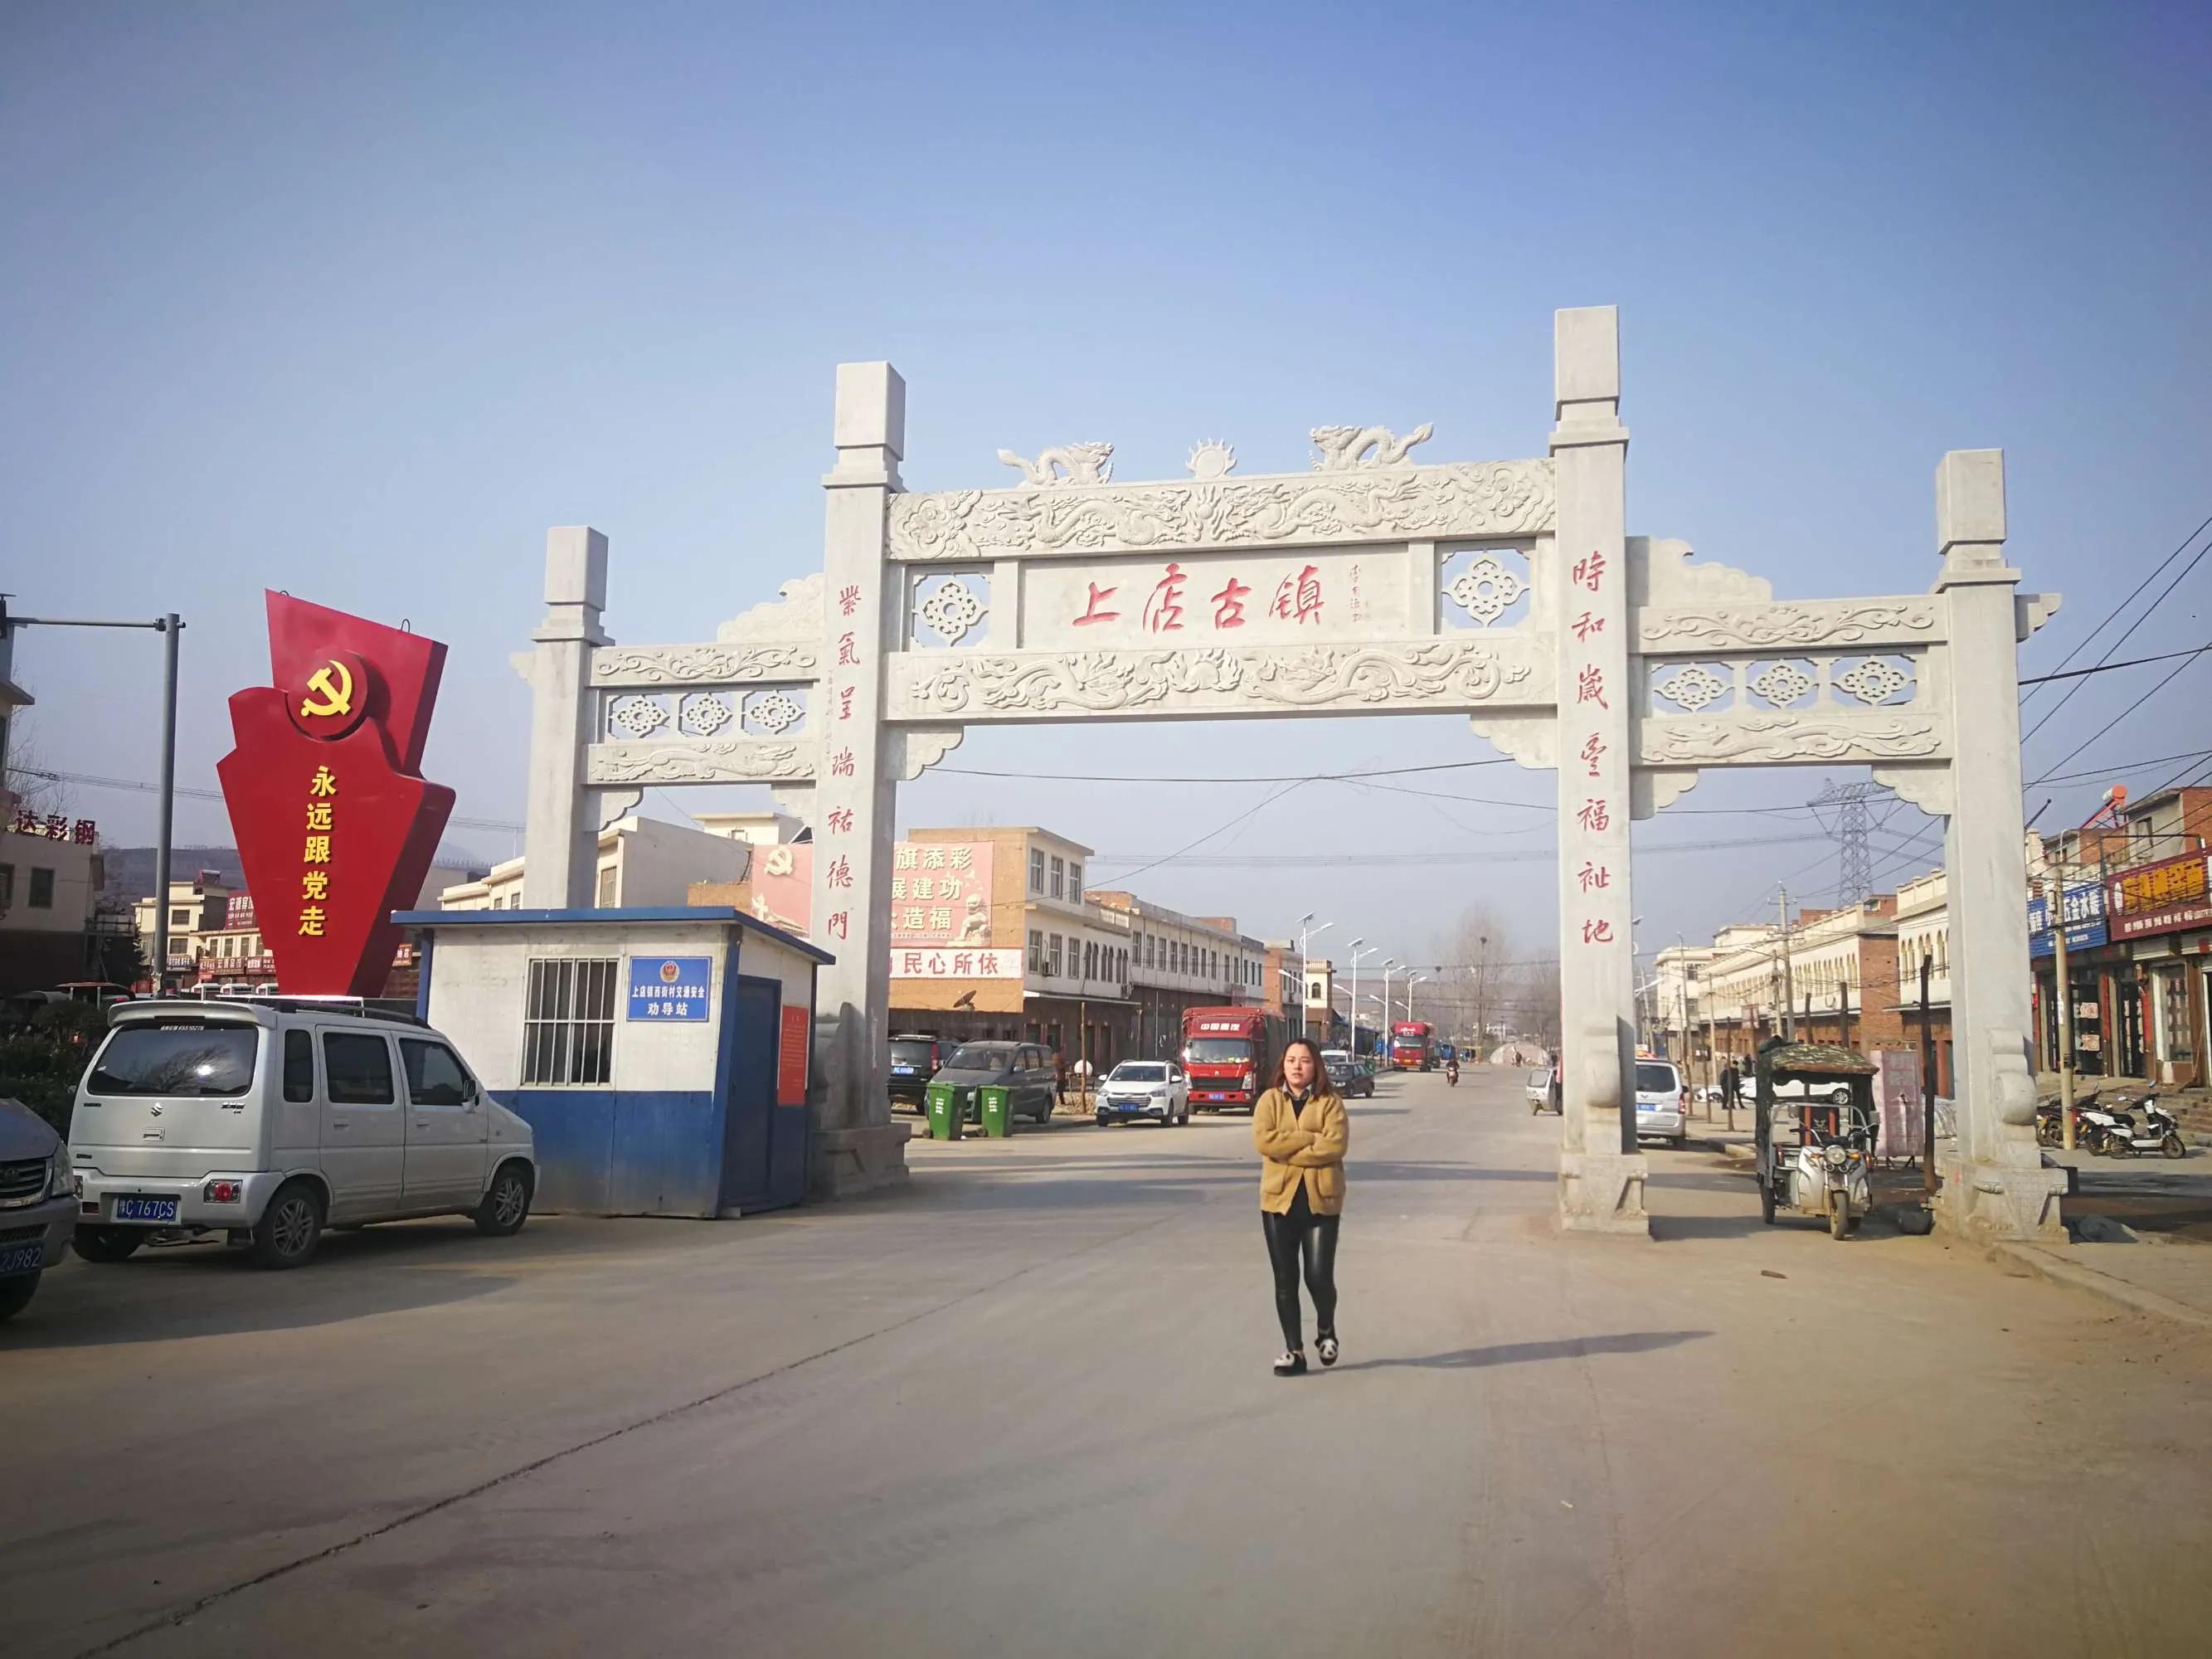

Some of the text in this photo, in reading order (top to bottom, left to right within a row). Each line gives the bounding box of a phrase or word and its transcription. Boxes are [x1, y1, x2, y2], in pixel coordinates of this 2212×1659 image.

[299, 765, 337, 936] 永远跟党走
[891, 906, 952, 931] 造福
[890, 952, 999, 975] 民心所依
[647, 1002, 688, 1016] 劝导站
[1200, 1023, 1241, 1031] 中国重汽
